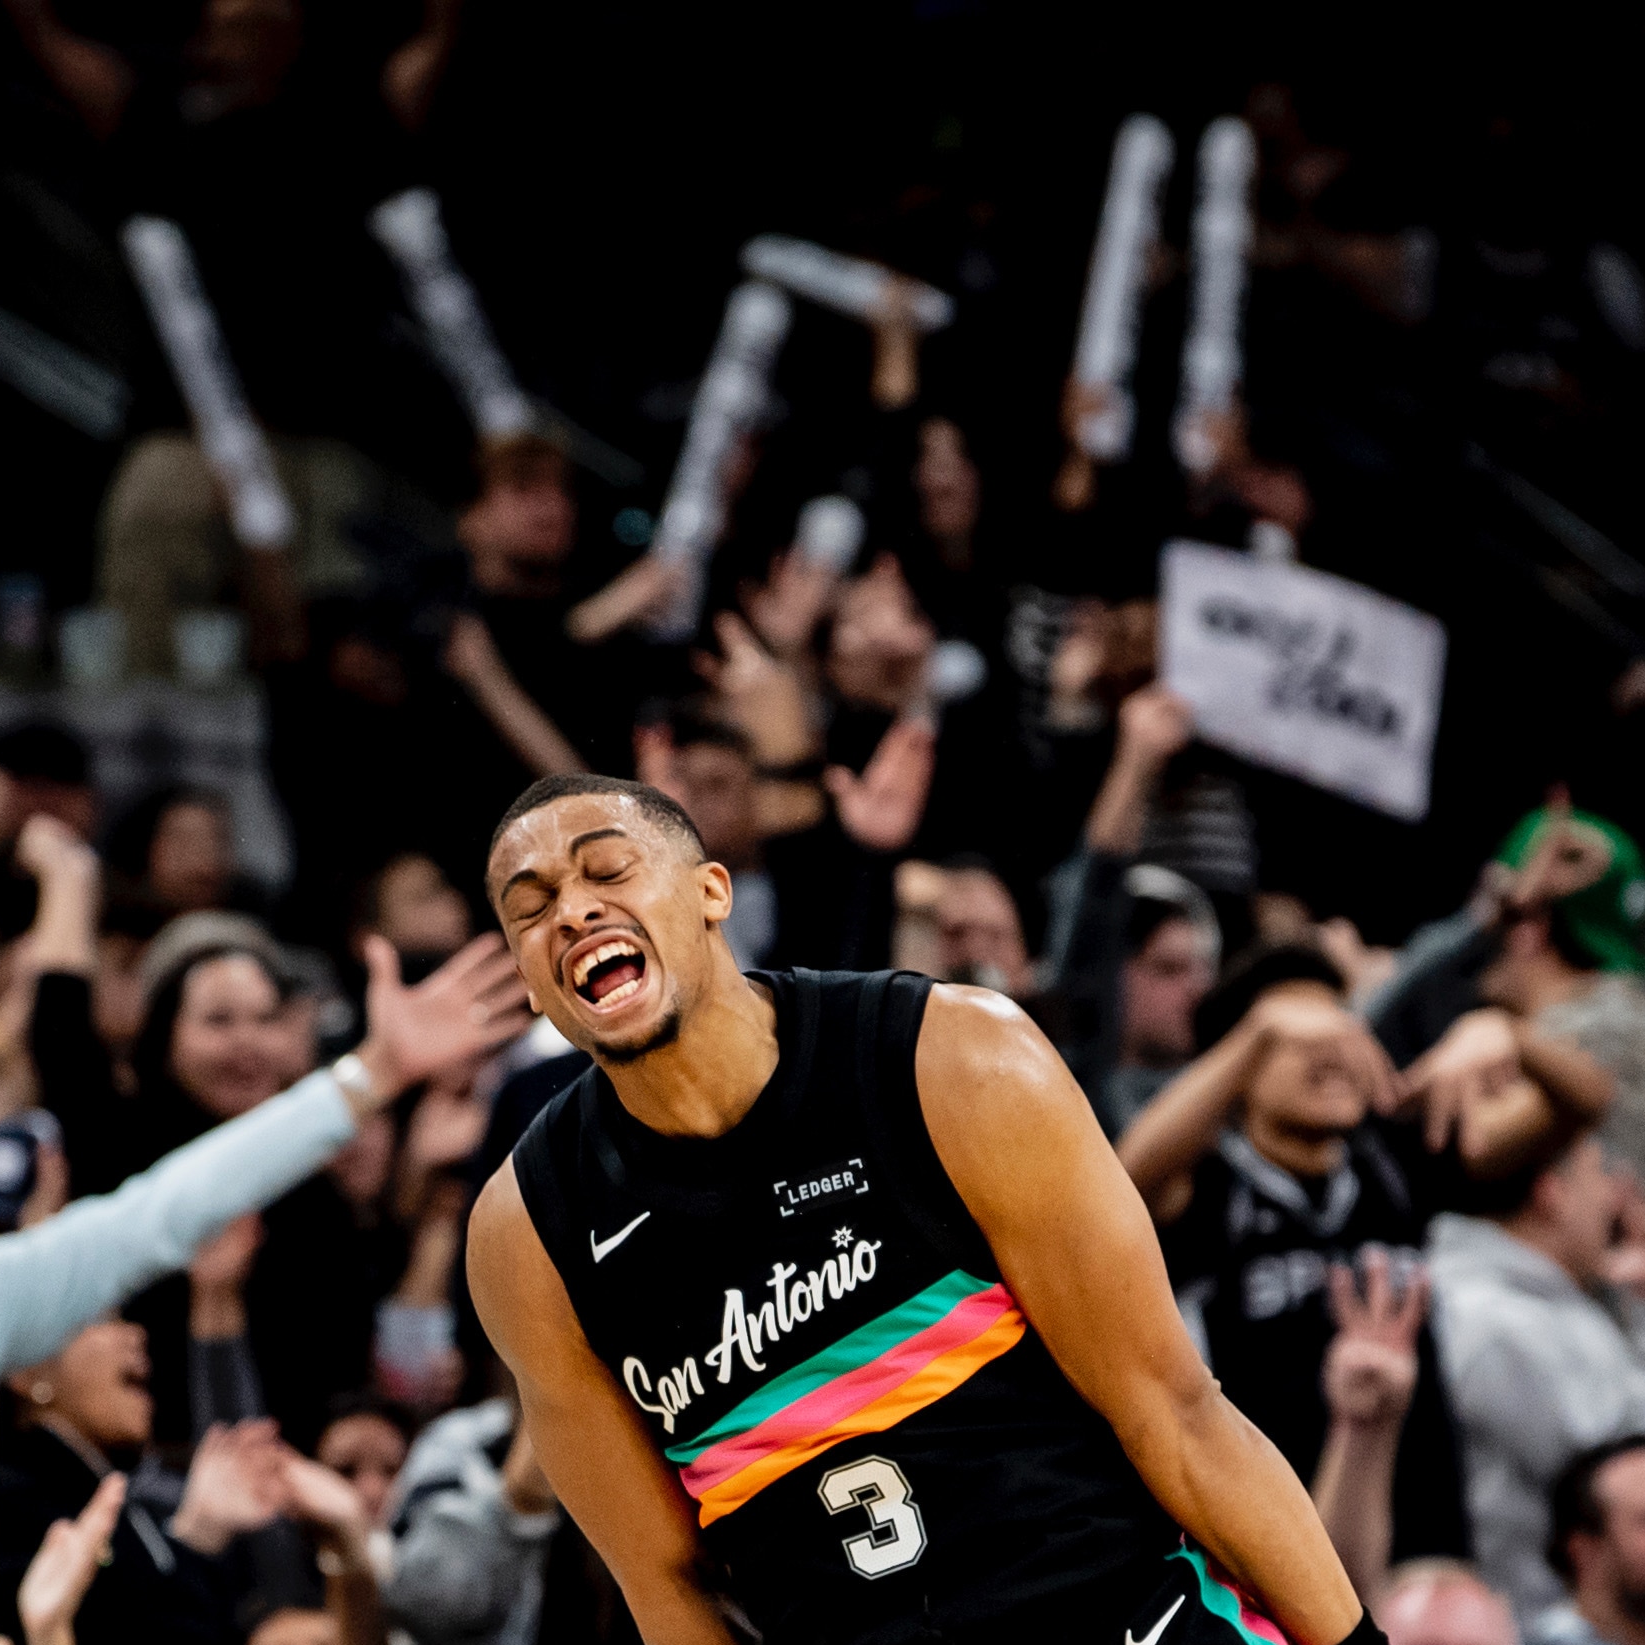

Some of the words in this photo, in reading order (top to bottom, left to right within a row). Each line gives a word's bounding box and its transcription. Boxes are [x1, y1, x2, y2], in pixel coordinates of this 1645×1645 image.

[788, 1171, 855, 1204] LEDGER
[623, 1356, 705, 1434] San
[705, 1228, 882, 1384] Antonio
[818, 1455, 927, 1580] 3
